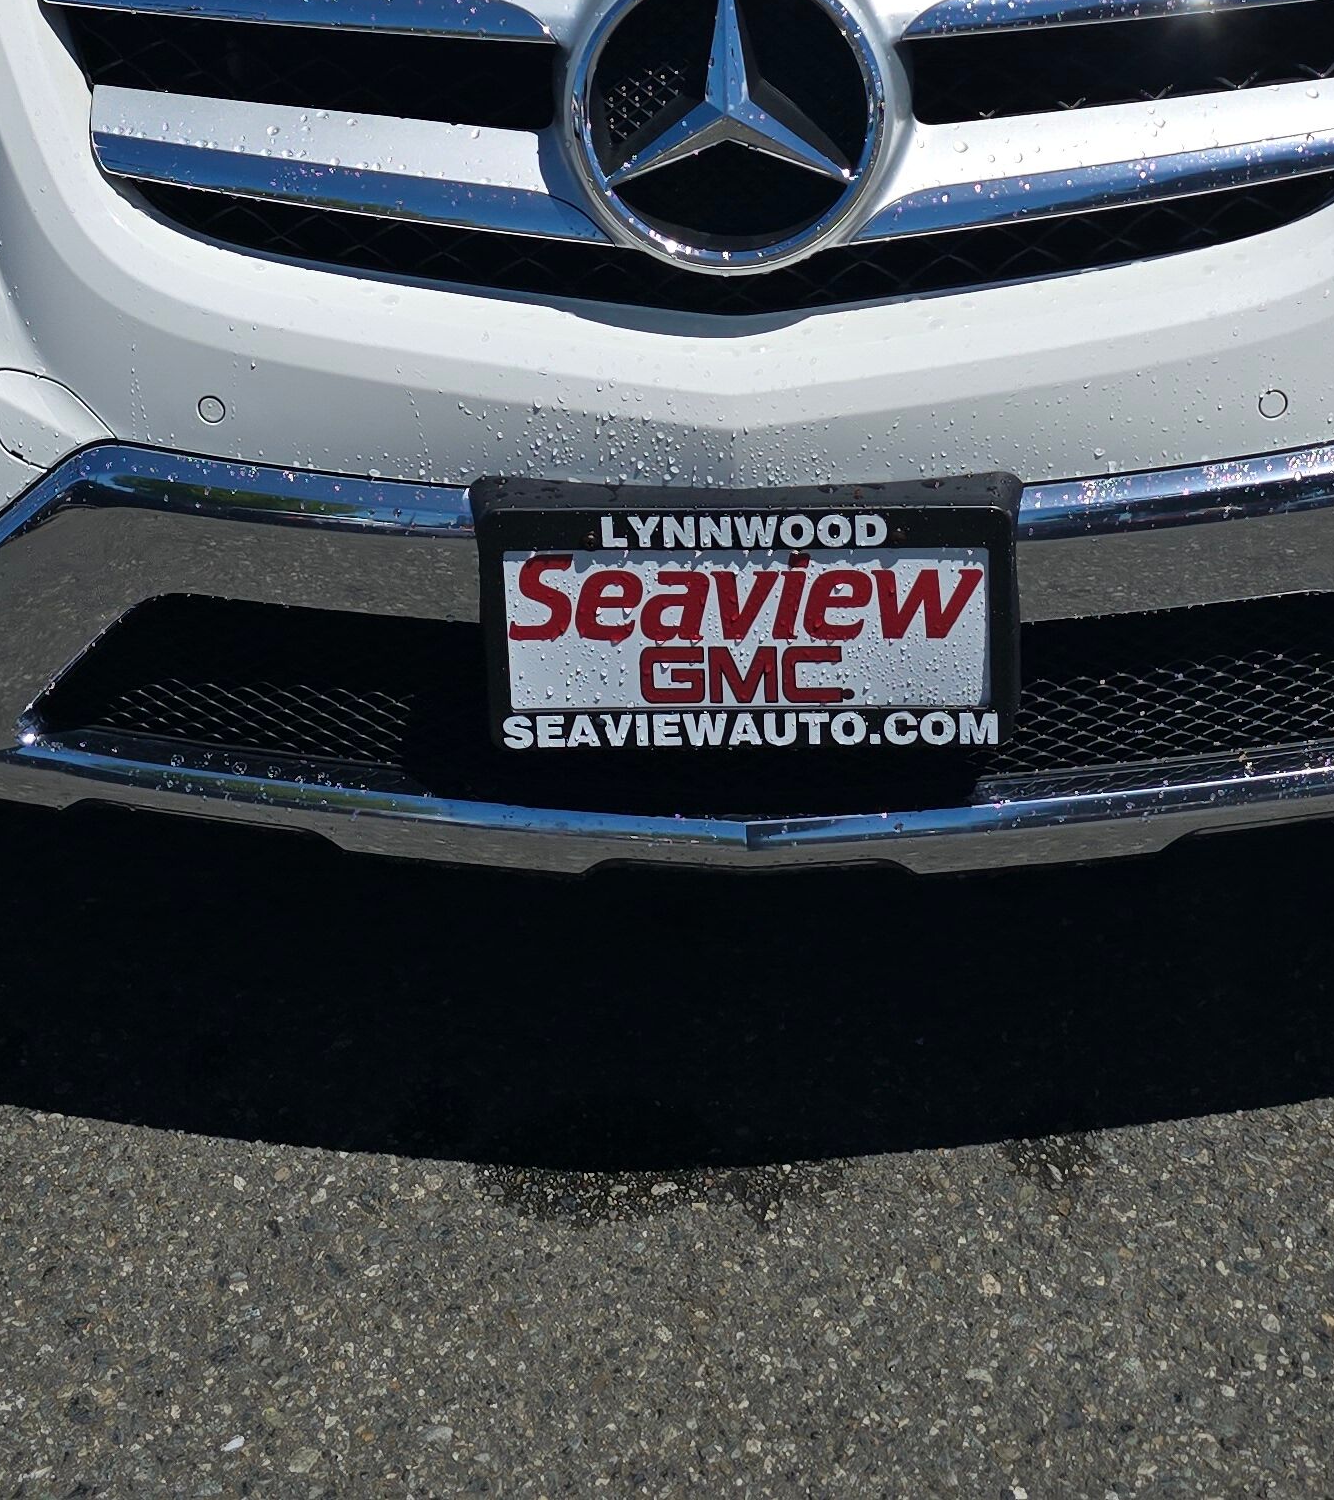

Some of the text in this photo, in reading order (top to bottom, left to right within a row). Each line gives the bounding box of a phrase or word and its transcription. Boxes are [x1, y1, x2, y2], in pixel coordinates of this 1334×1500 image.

[600, 514, 889, 549] LYNNWOOD
[509, 552, 984, 643] Seaview
[639, 646, 845, 704] GMC
[502, 711, 999, 750] SEAVIEWAUTO.COM
